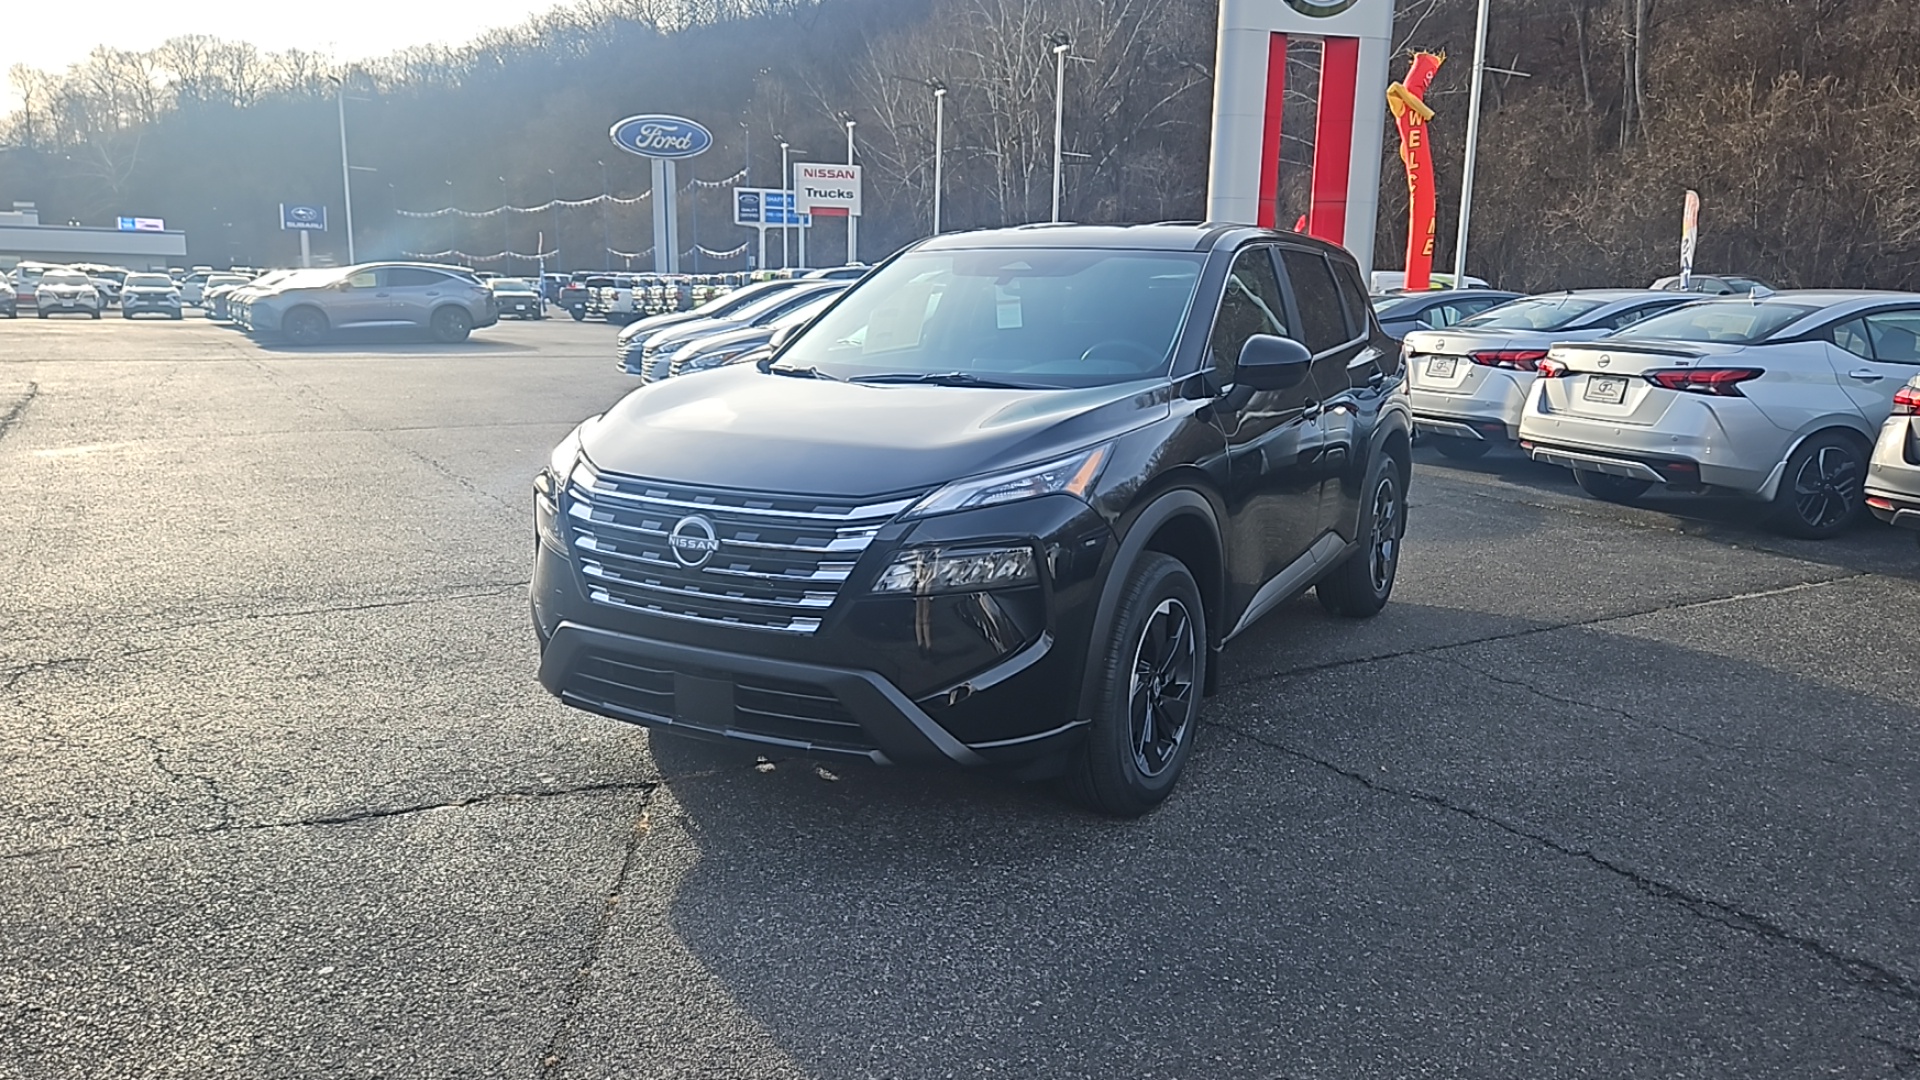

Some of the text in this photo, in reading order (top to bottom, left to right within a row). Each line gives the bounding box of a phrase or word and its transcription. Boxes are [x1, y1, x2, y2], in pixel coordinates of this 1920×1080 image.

[635, 123, 693, 150] Ford
[803, 168, 856, 180] NISSAN
[1408, 110, 1436, 256] WELCE
[804, 187, 855, 200] Trucks
[286, 221, 323, 230] SUBARU
[668, 535, 719, 551] NISSAN
